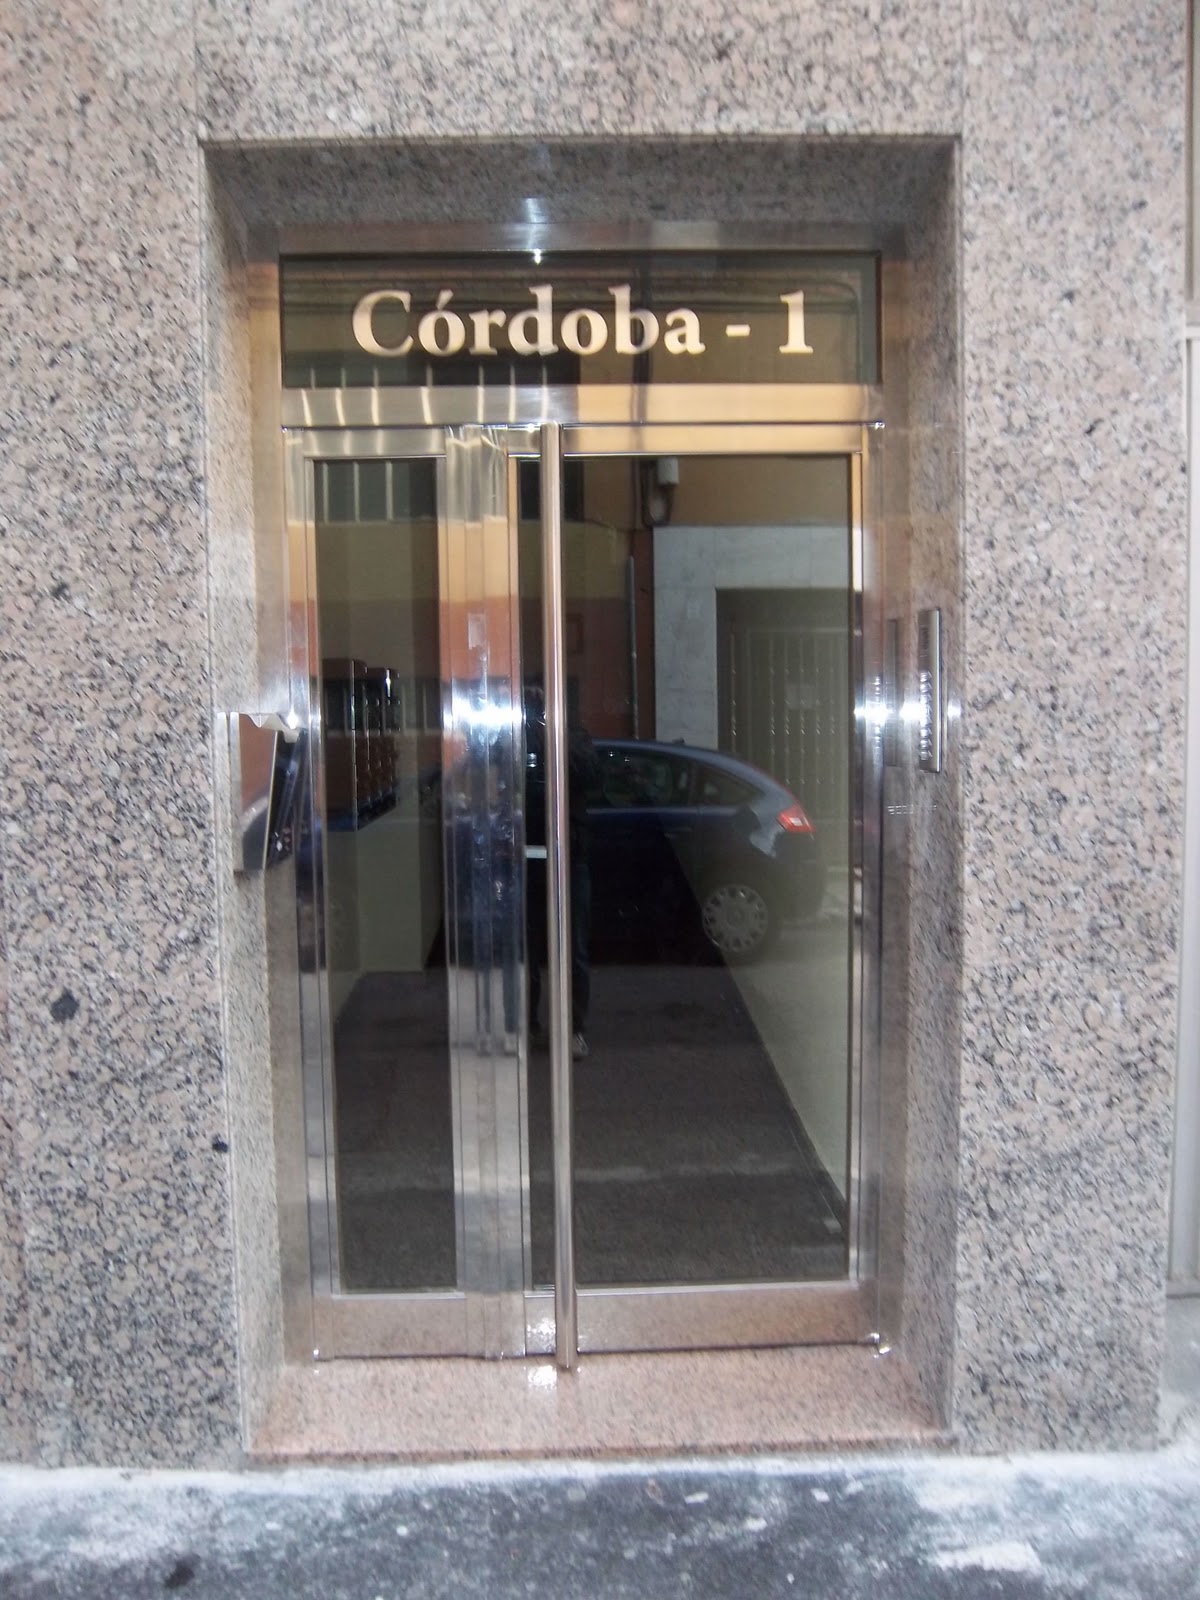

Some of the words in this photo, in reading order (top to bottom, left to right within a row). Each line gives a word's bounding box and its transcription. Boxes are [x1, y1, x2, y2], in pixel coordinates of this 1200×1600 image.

[352, 284, 706, 357] Córdoba
[726, 323, 751, 338] -
[778, 290, 814, 354] 1
